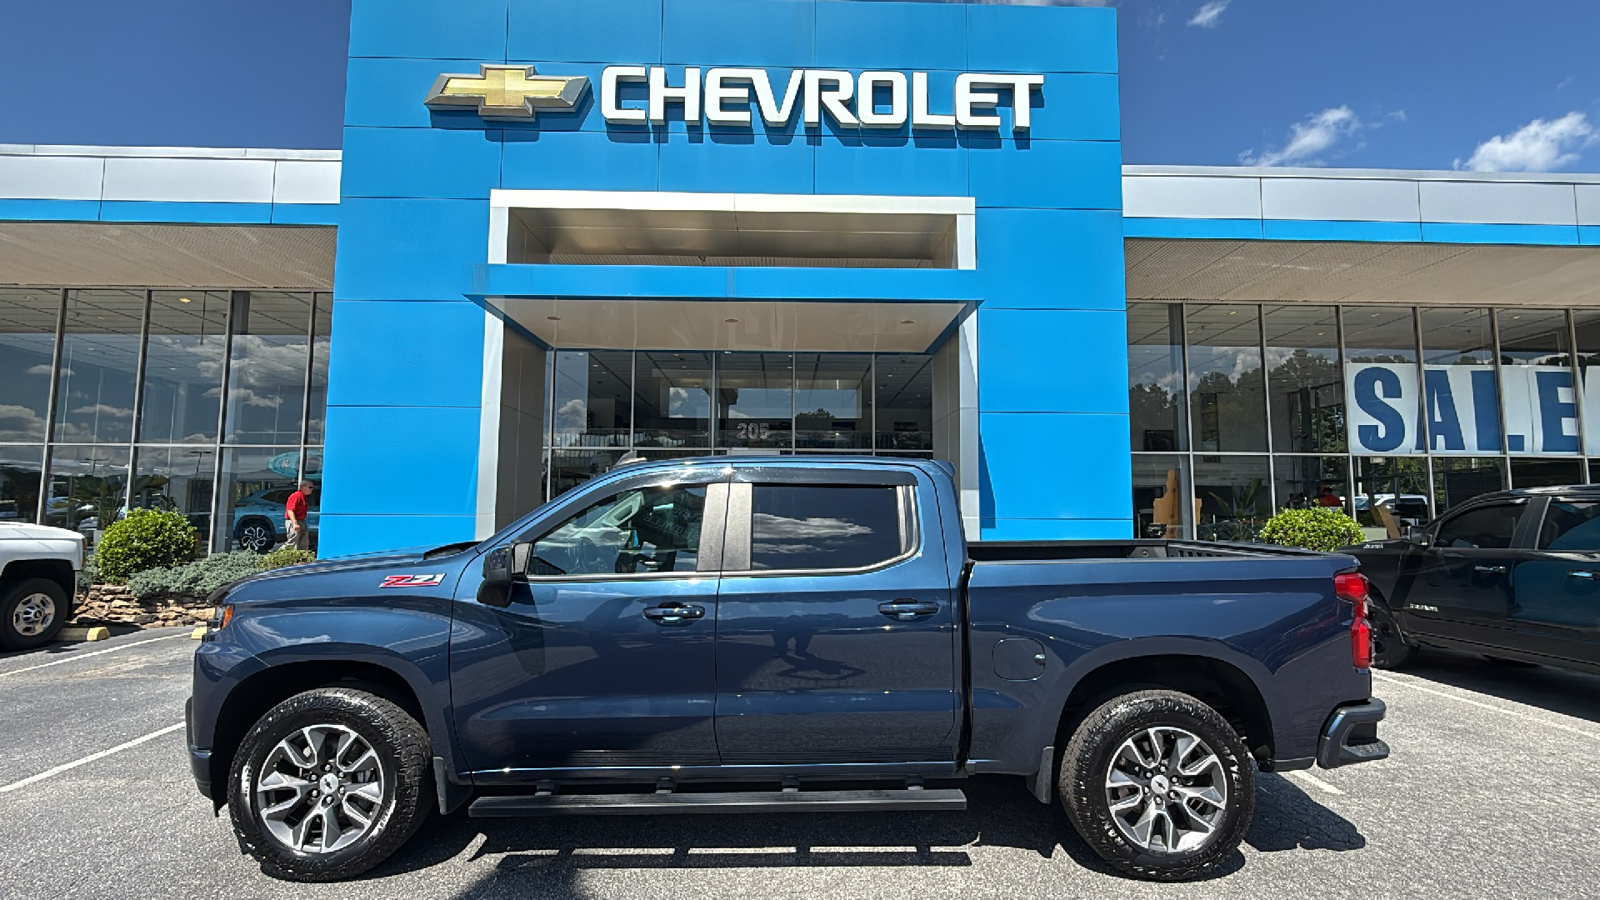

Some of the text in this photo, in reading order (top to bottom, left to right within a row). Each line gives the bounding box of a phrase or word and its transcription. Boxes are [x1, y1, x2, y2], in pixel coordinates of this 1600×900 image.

[600, 65, 1045, 132] CHEVROLET
[736, 422, 770, 439] 205
[1354, 366, 1580, 453] SALE
[378, 573, 447, 589] Z71
